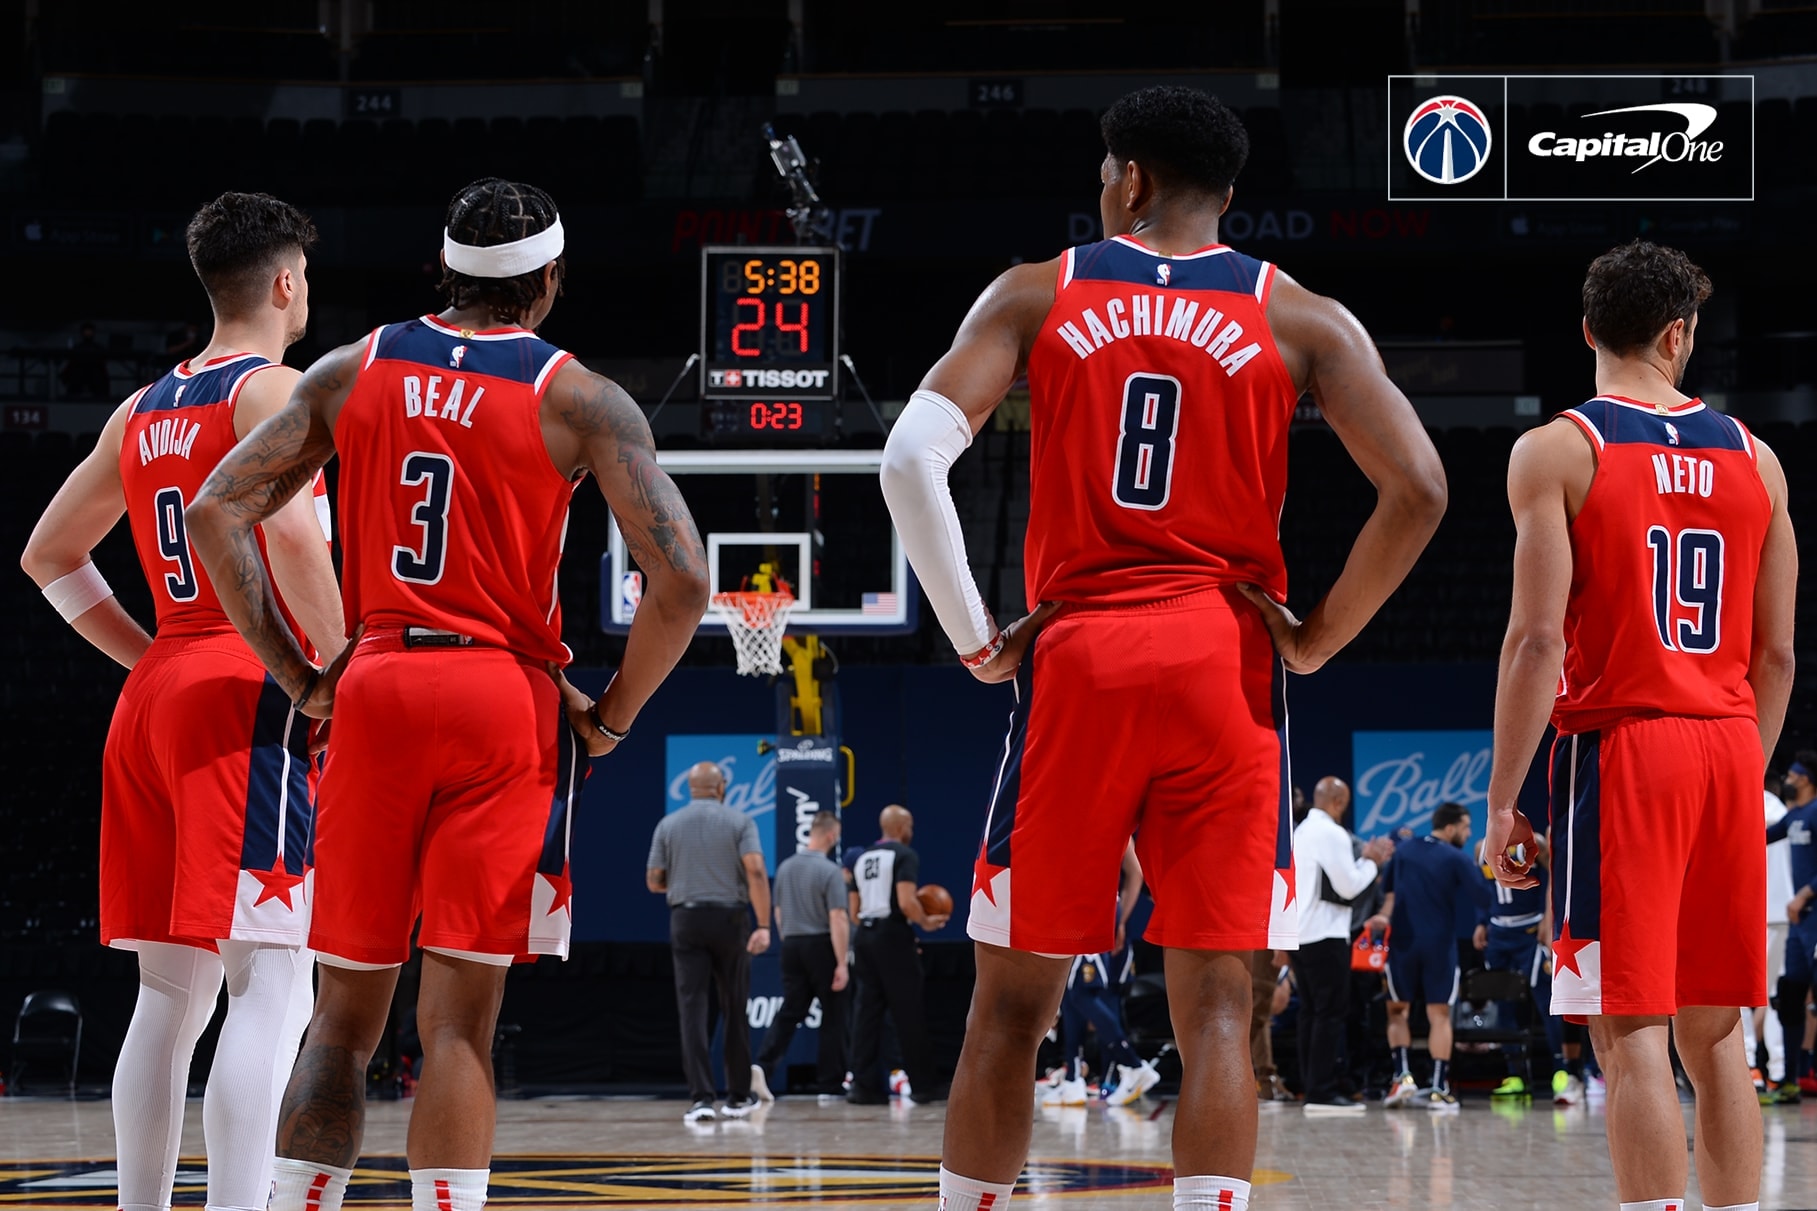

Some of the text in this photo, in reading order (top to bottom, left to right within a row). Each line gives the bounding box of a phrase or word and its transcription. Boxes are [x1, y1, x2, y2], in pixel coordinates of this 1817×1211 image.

[356, 94, 392, 112] 244
[977, 84, 1015, 101] 246
[1330, 208, 1431, 240] NOW
[743, 257, 821, 295] 5:38
[731, 297, 810, 357] 24
[1057, 294, 1262, 377] HACHIMURA
[403, 375, 485, 428] BEAL
[742, 369, 829, 388] TISSOT
[13, 409, 41, 424] 134
[750, 401, 804, 430] 0:23
[139, 417, 201, 467] AVDIJA
[1112, 371, 1182, 511] 8
[1651, 453, 1714, 498] NETO
[391, 451, 455, 586] 3
[154, 486, 199, 602] 9
[1647, 525, 1725, 654] 19
[1356, 748, 1491, 833] Ball
